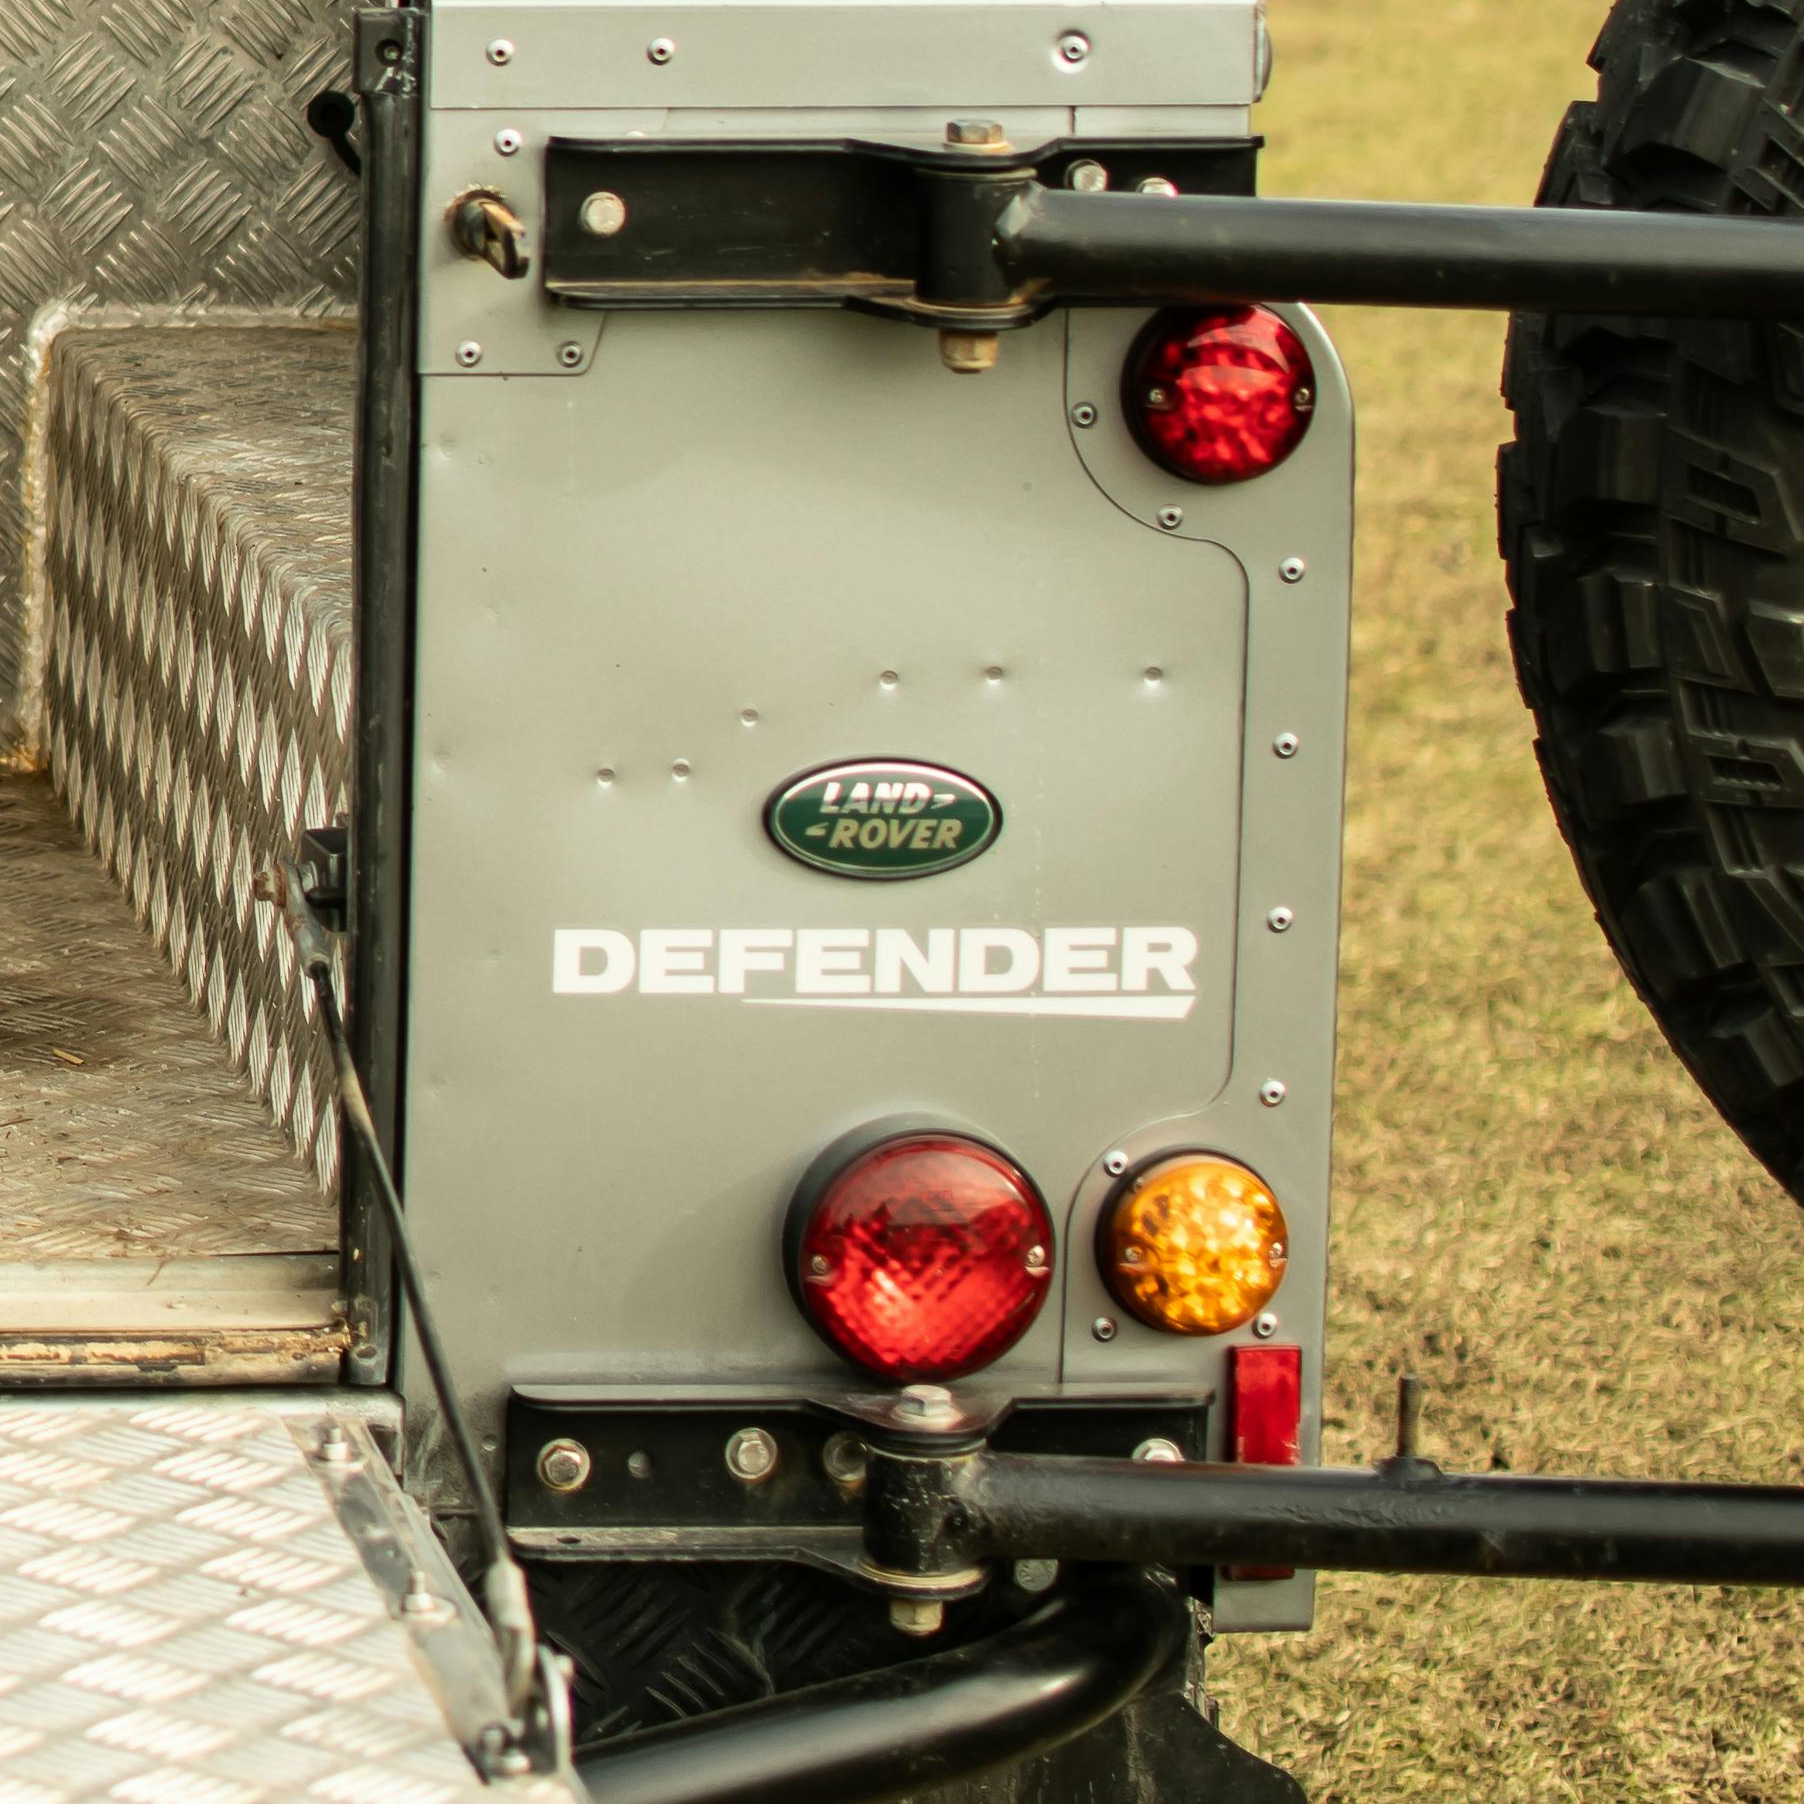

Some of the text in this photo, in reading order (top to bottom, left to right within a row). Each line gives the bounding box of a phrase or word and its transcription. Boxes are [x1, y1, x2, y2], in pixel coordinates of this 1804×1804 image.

[820, 781, 933, 814] LAND
[829, 818, 962, 850] ROVER
[552, 926, 1198, 994] DEFENDER
